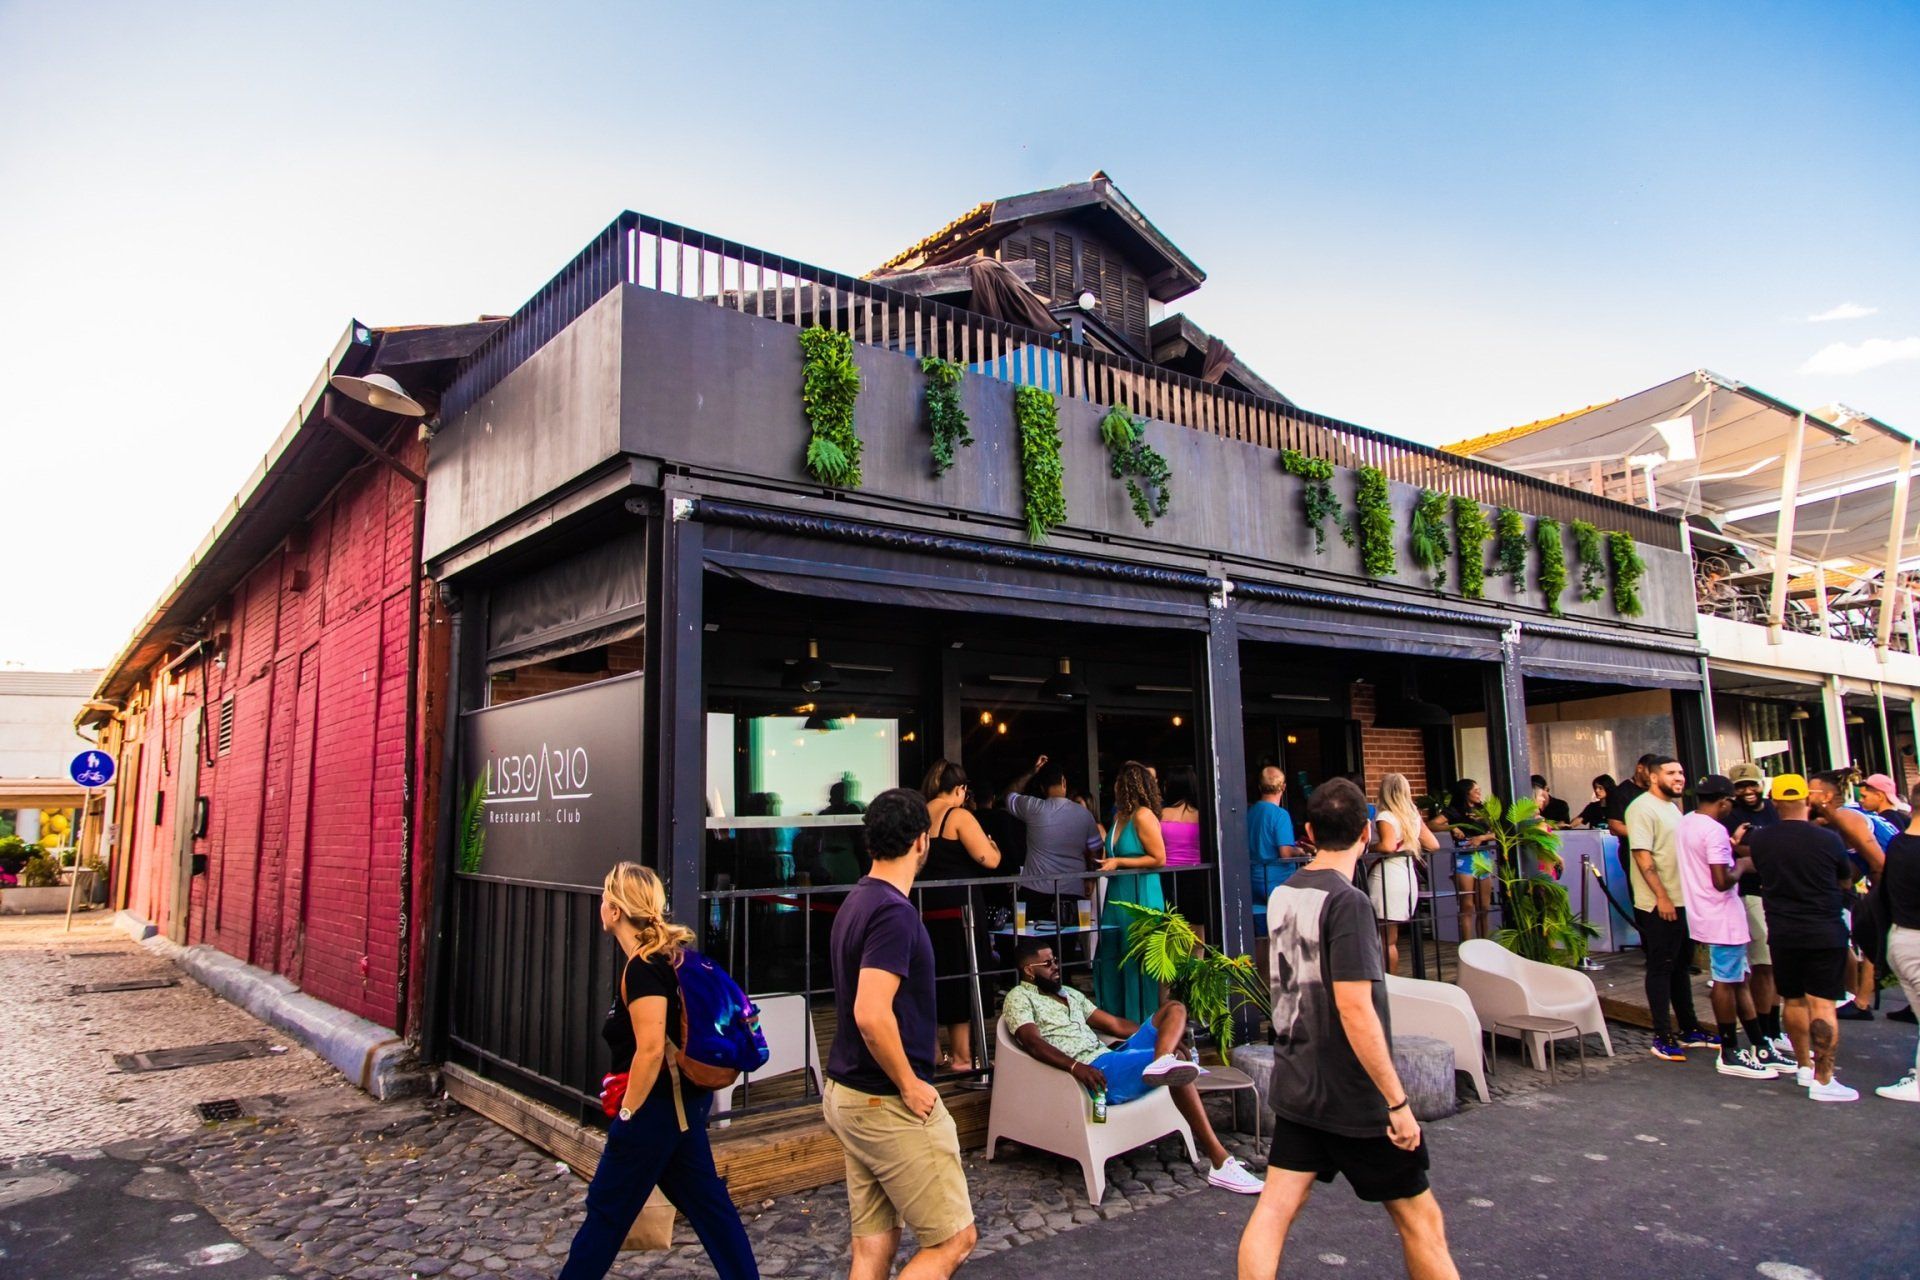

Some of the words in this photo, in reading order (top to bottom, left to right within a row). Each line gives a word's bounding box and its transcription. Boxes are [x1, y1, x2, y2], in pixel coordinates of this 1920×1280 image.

[486, 742, 588, 800] LISBOARIO
[489, 810, 541, 824] Restaurant
[556, 808, 581, 823] Club
